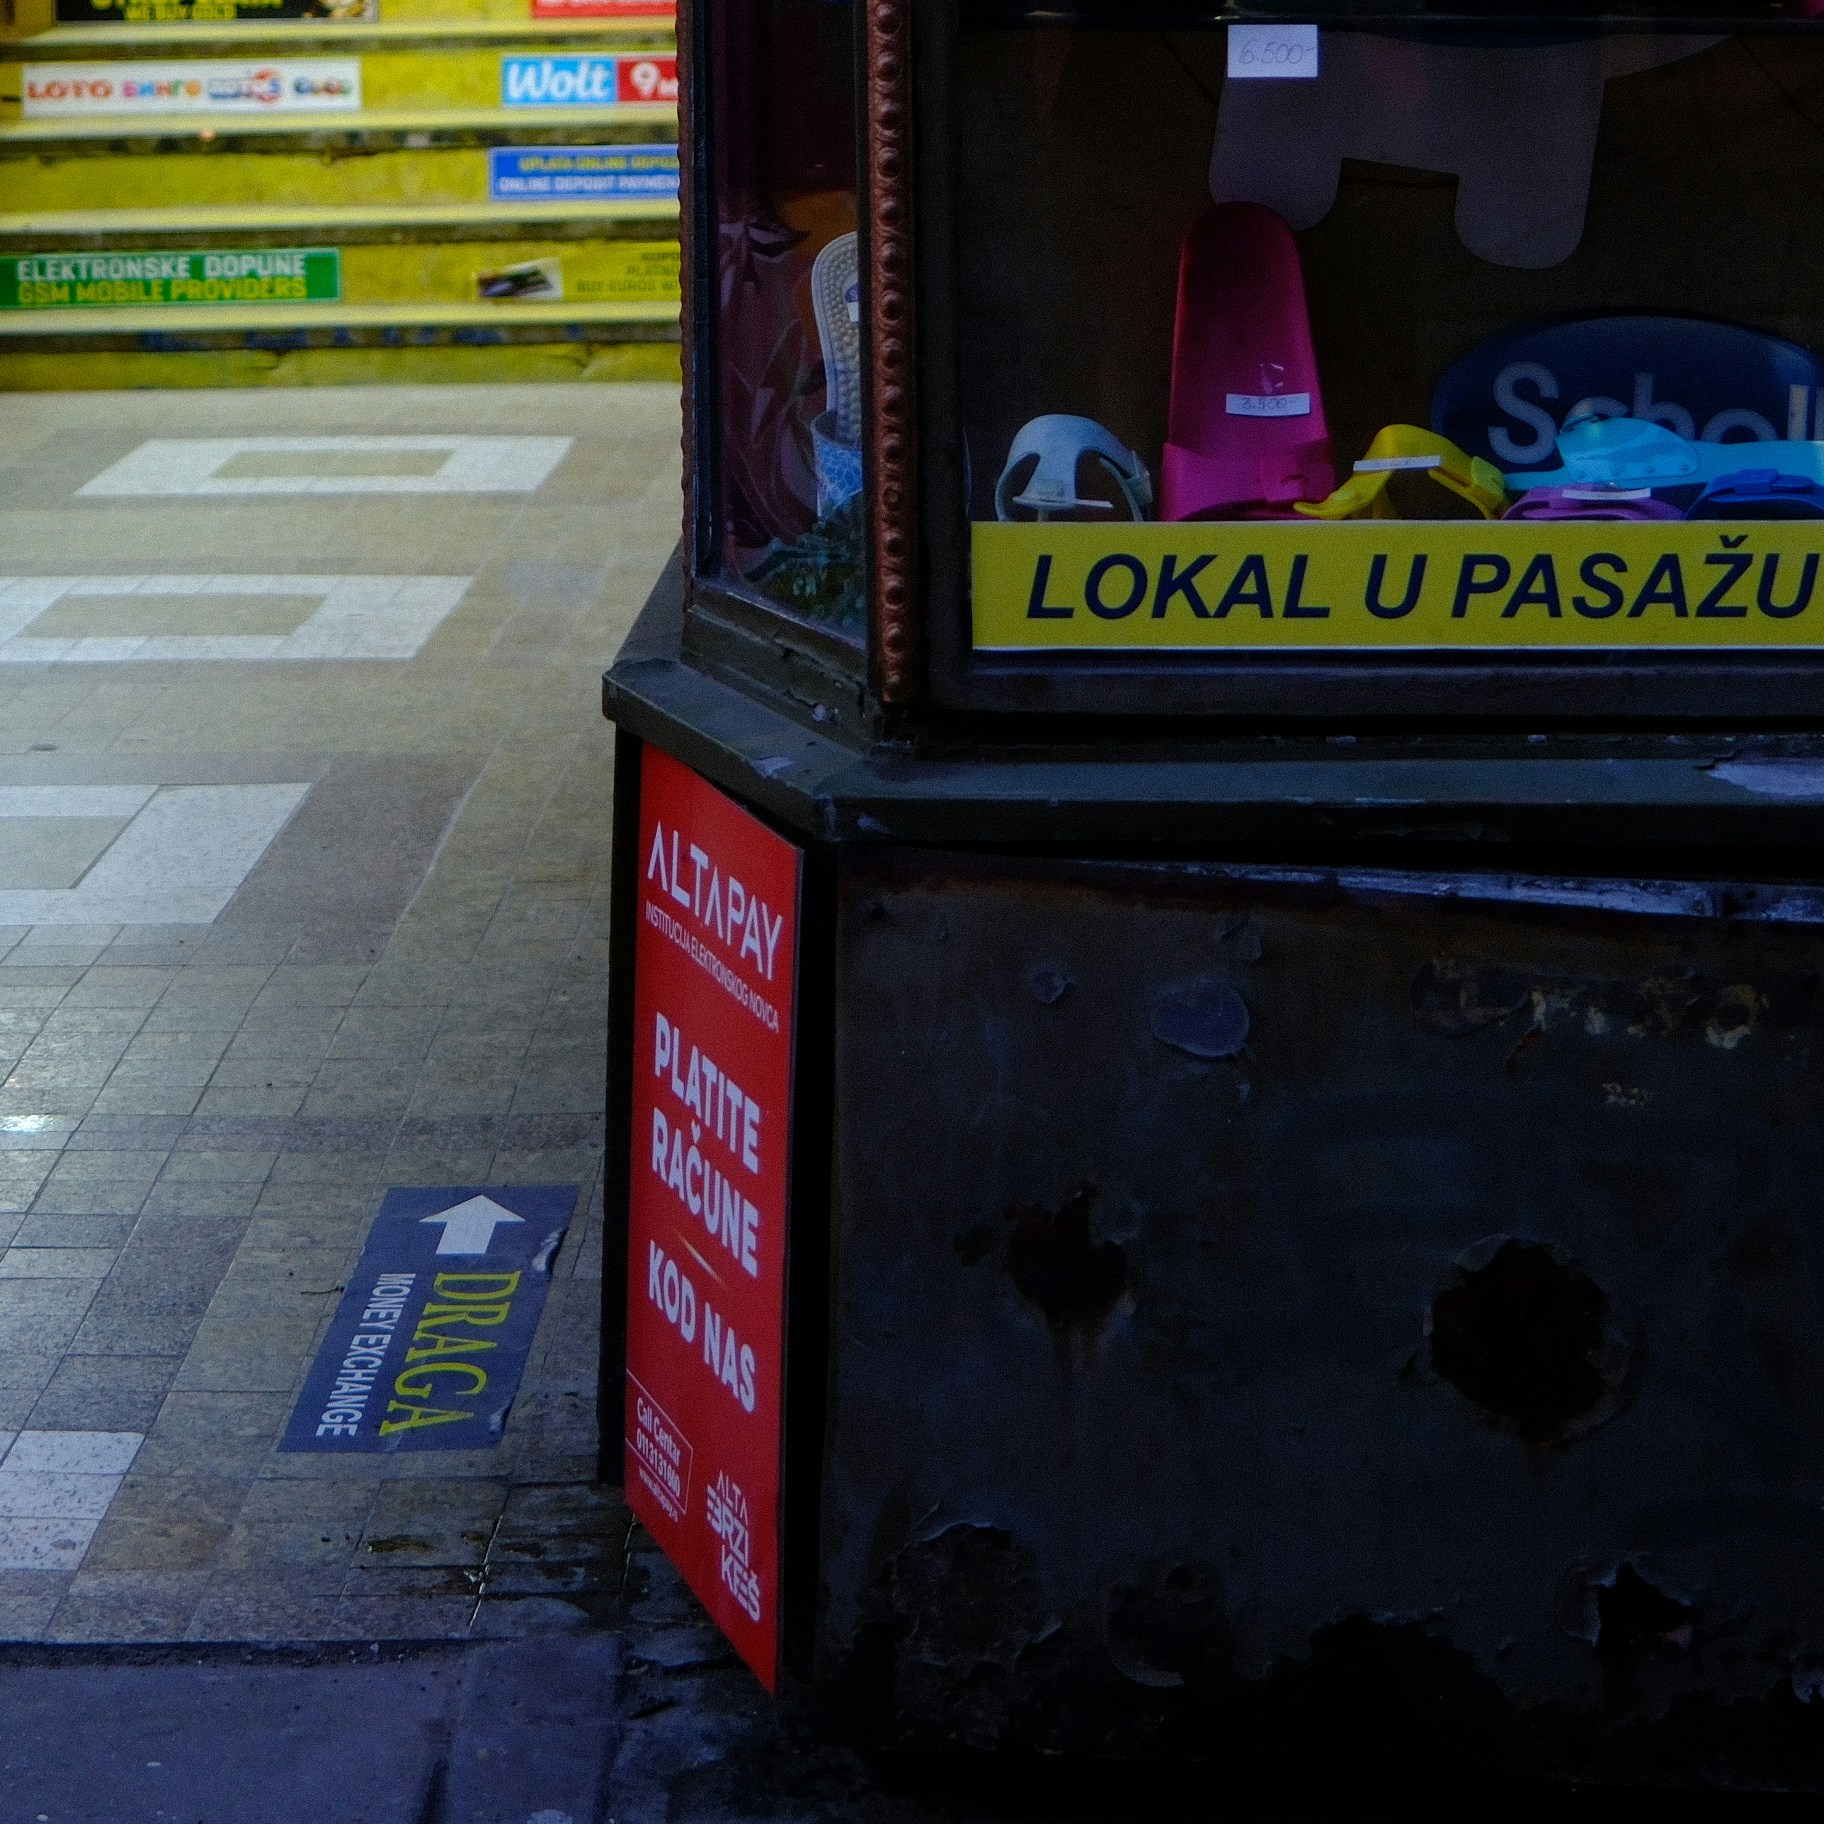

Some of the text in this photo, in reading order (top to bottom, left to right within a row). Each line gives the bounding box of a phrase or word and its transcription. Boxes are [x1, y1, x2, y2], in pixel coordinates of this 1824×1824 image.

[27, 79, 114, 101] LOTO
[505, 60, 614, 102] Wolt
[17, 253, 307, 281] ELEKTRONSKE DOPUNE
[17, 277, 308, 304] GSM MOBILE PROVIDERS
[1026, 534, 1821, 620] LOKAL U PASAŽU
[647, 820, 784, 982] ALTAPAY
[654, 1011, 760, 1174] PLATITE
[651, 1106, 758, 1277] RAČUNE
[315, 1272, 417, 1438] MONEY EXCHANGE
[378, 1270, 522, 1440] DRAGA
[648, 1239, 756, 1414] KOD NAS
[637, 1396, 654, 1434] Call
[716, 1469, 749, 1526] ALTA
